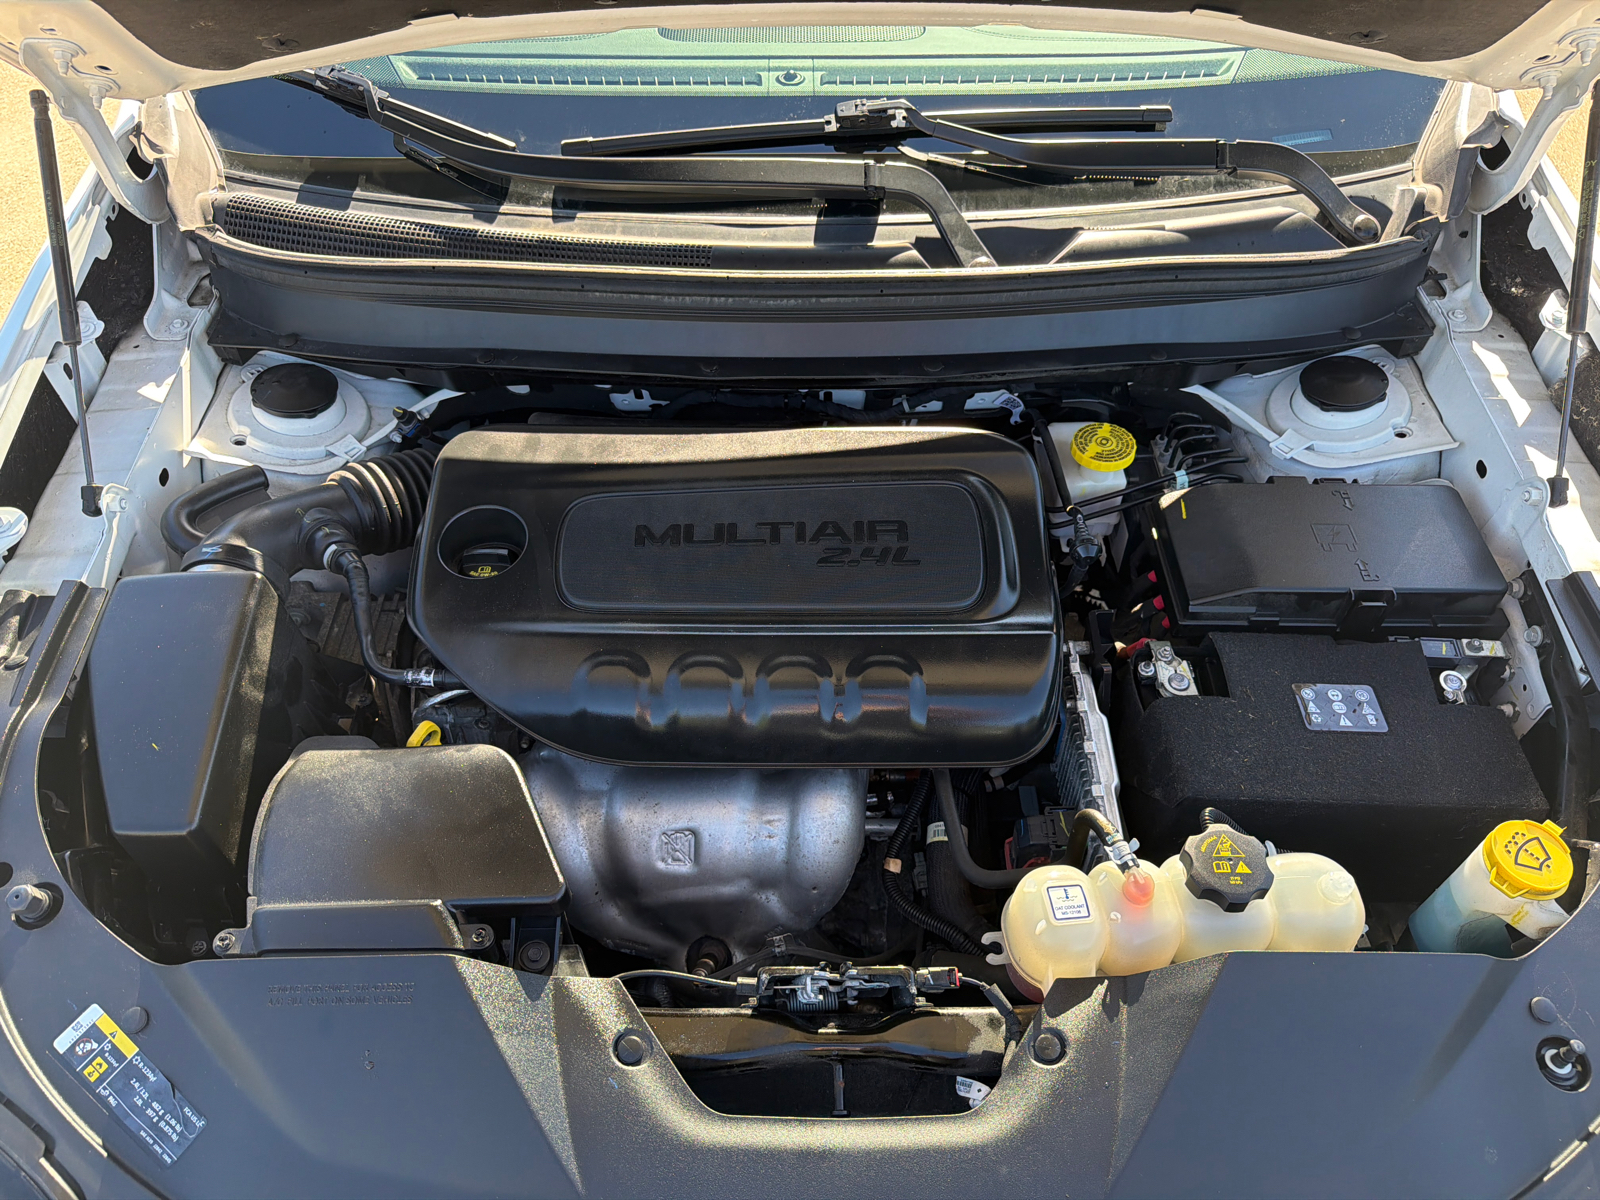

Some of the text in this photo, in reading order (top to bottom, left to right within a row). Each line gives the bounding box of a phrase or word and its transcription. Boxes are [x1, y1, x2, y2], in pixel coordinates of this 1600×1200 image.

[635, 520, 909, 547] MULTIAIR
[816, 545, 921, 567] 2.4L
[303, 983, 322, 994] THIS
[323, 983, 350, 993] PANEL
[353, 983, 369, 993] FOR
[371, 982, 404, 992] ACCESS
[286, 996, 303, 1007] FILL
[330, 996, 344, 1006] ON
[345, 995, 371, 1005] SOME
[372, 994, 414, 1005] VEHICLES
[137, 1061, 157, 1082] R-1234yf
[183, 1106, 192, 1116] FCA
